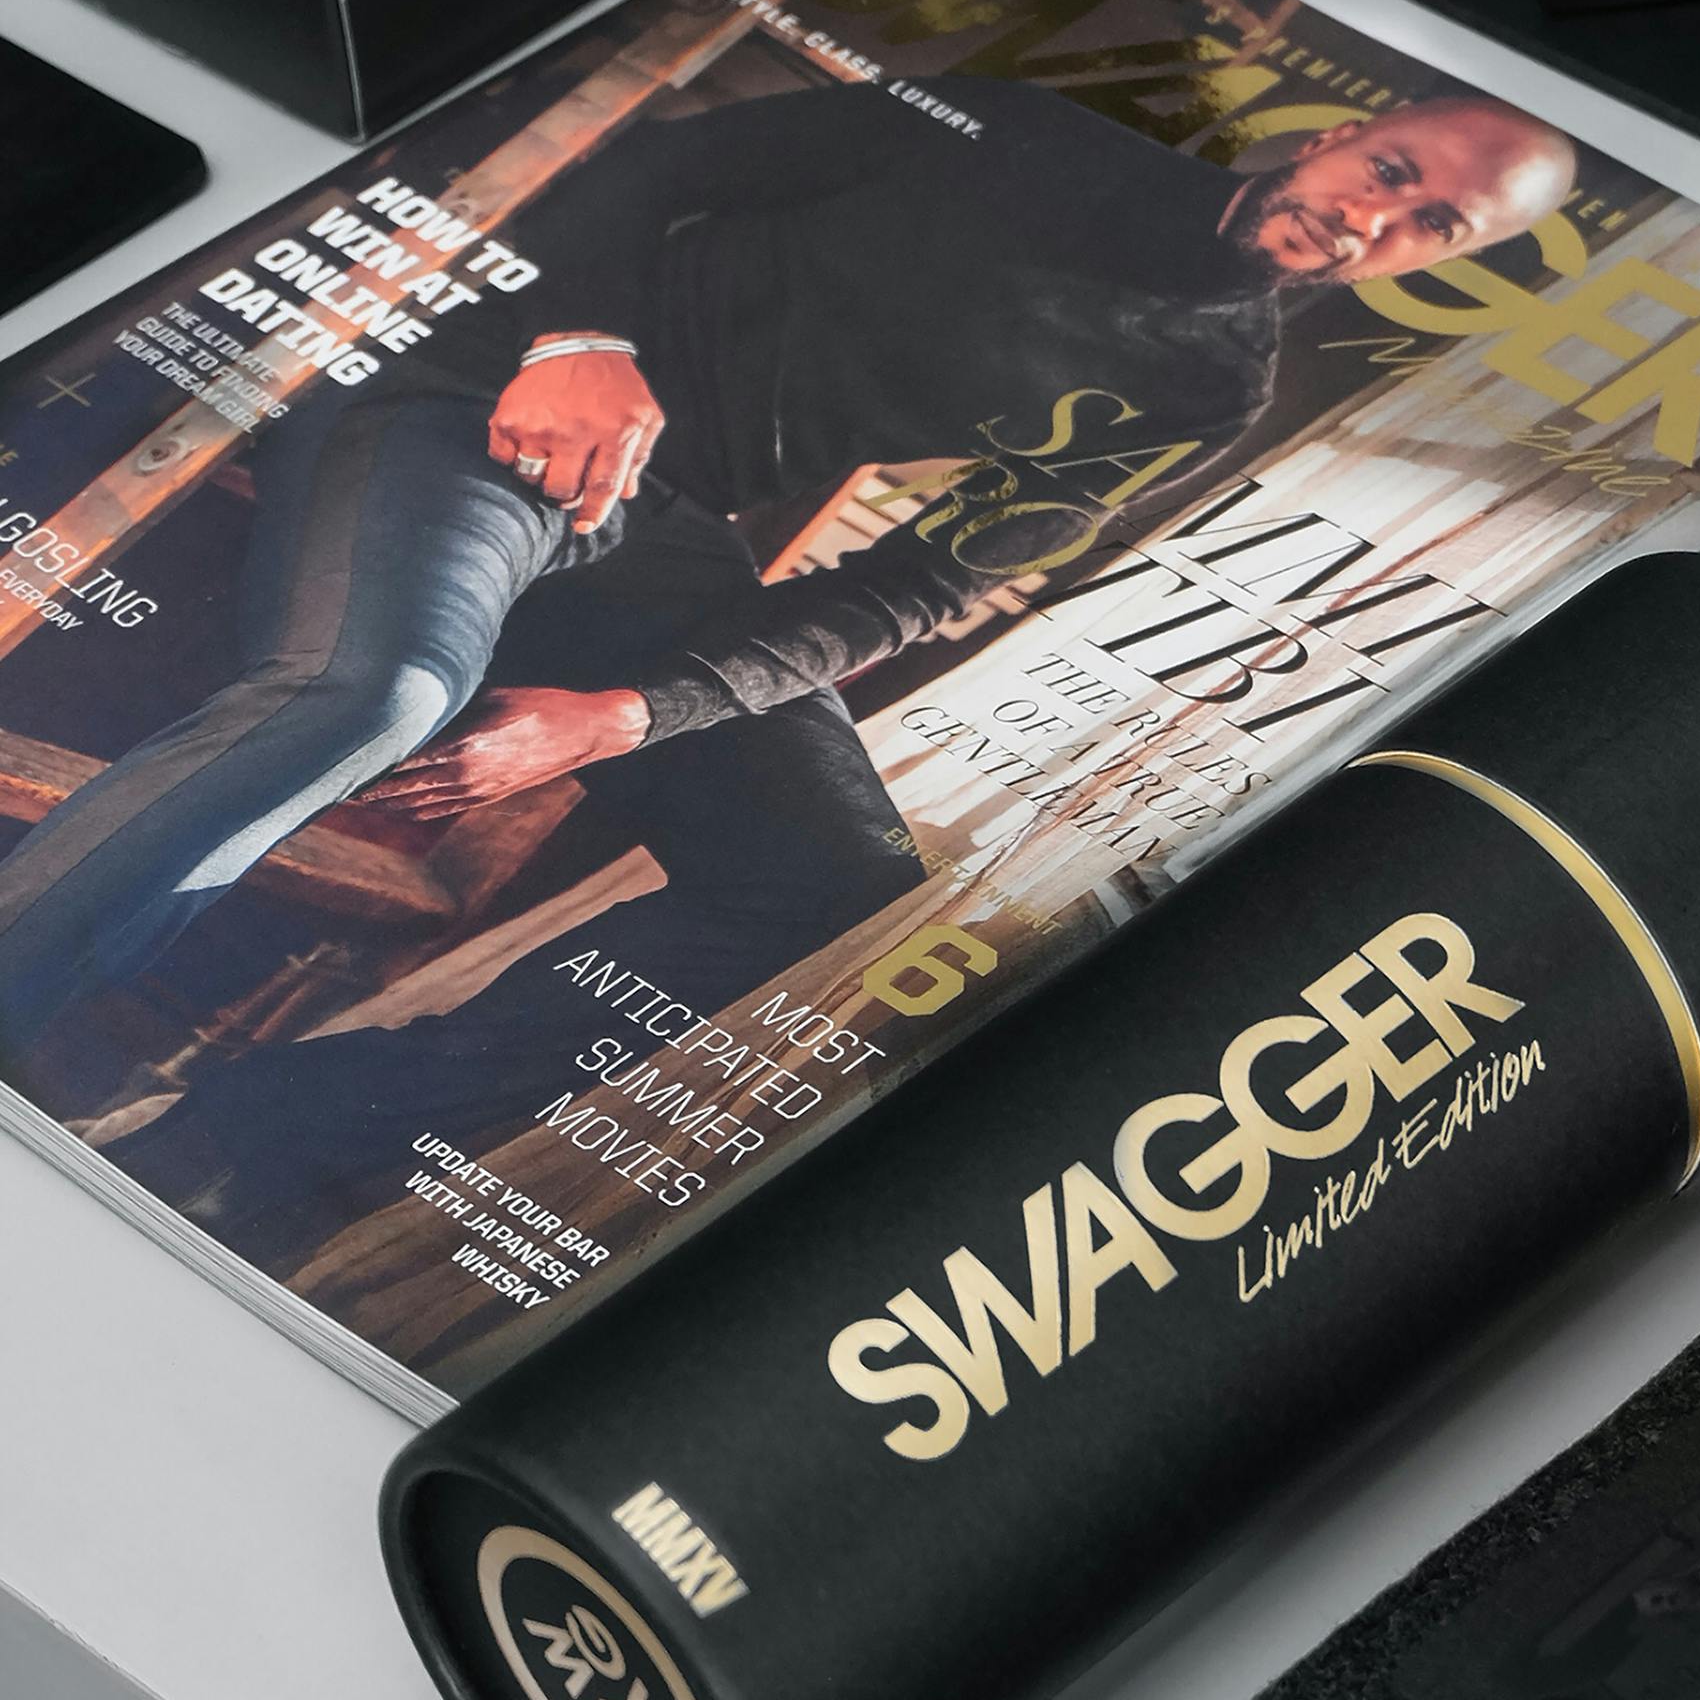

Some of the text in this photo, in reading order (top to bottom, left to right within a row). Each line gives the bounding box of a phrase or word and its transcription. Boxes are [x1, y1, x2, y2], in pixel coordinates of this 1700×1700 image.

[306, 207, 482, 315] WIN AT
[356, 177, 541, 293] HOW TO
[161, 302, 284, 384] THE ULTIMATE
[198, 268, 380, 386] DATING
[254, 239, 433, 353] ONLINE
[113, 330, 261, 434] YOUR DREAM GIRL
[136, 317, 290, 419] GUIDE TO FINDING
[0, 513, 158, 627] GOSLING
[0, 569, 83, 630] EVERYDAY
[900, 705, 1178, 862] GENTLEMAN
[992, 699, 1225, 830] OF A TRUE
[1020, 653, 1272, 797] THE RULES
[863, 925, 998, 1016] 6
[553, 949, 822, 1120] ANTICIPATED
[751, 992, 886, 1075] MOST
[535, 1091, 706, 1208] MOVIES
[575, 1038, 765, 1165] SUMMER
[411, 1132, 610, 1267] UPDATE YOUR BAR
[827, 911, 1526, 1462] SWAGGER
[1236, 1038, 1547, 1303] Limited Edition
[405, 1171, 582, 1290] WITH JAPANESE
[451, 1244, 552, 1312] WHISKY
[611, 1481, 750, 1618] MMXV
